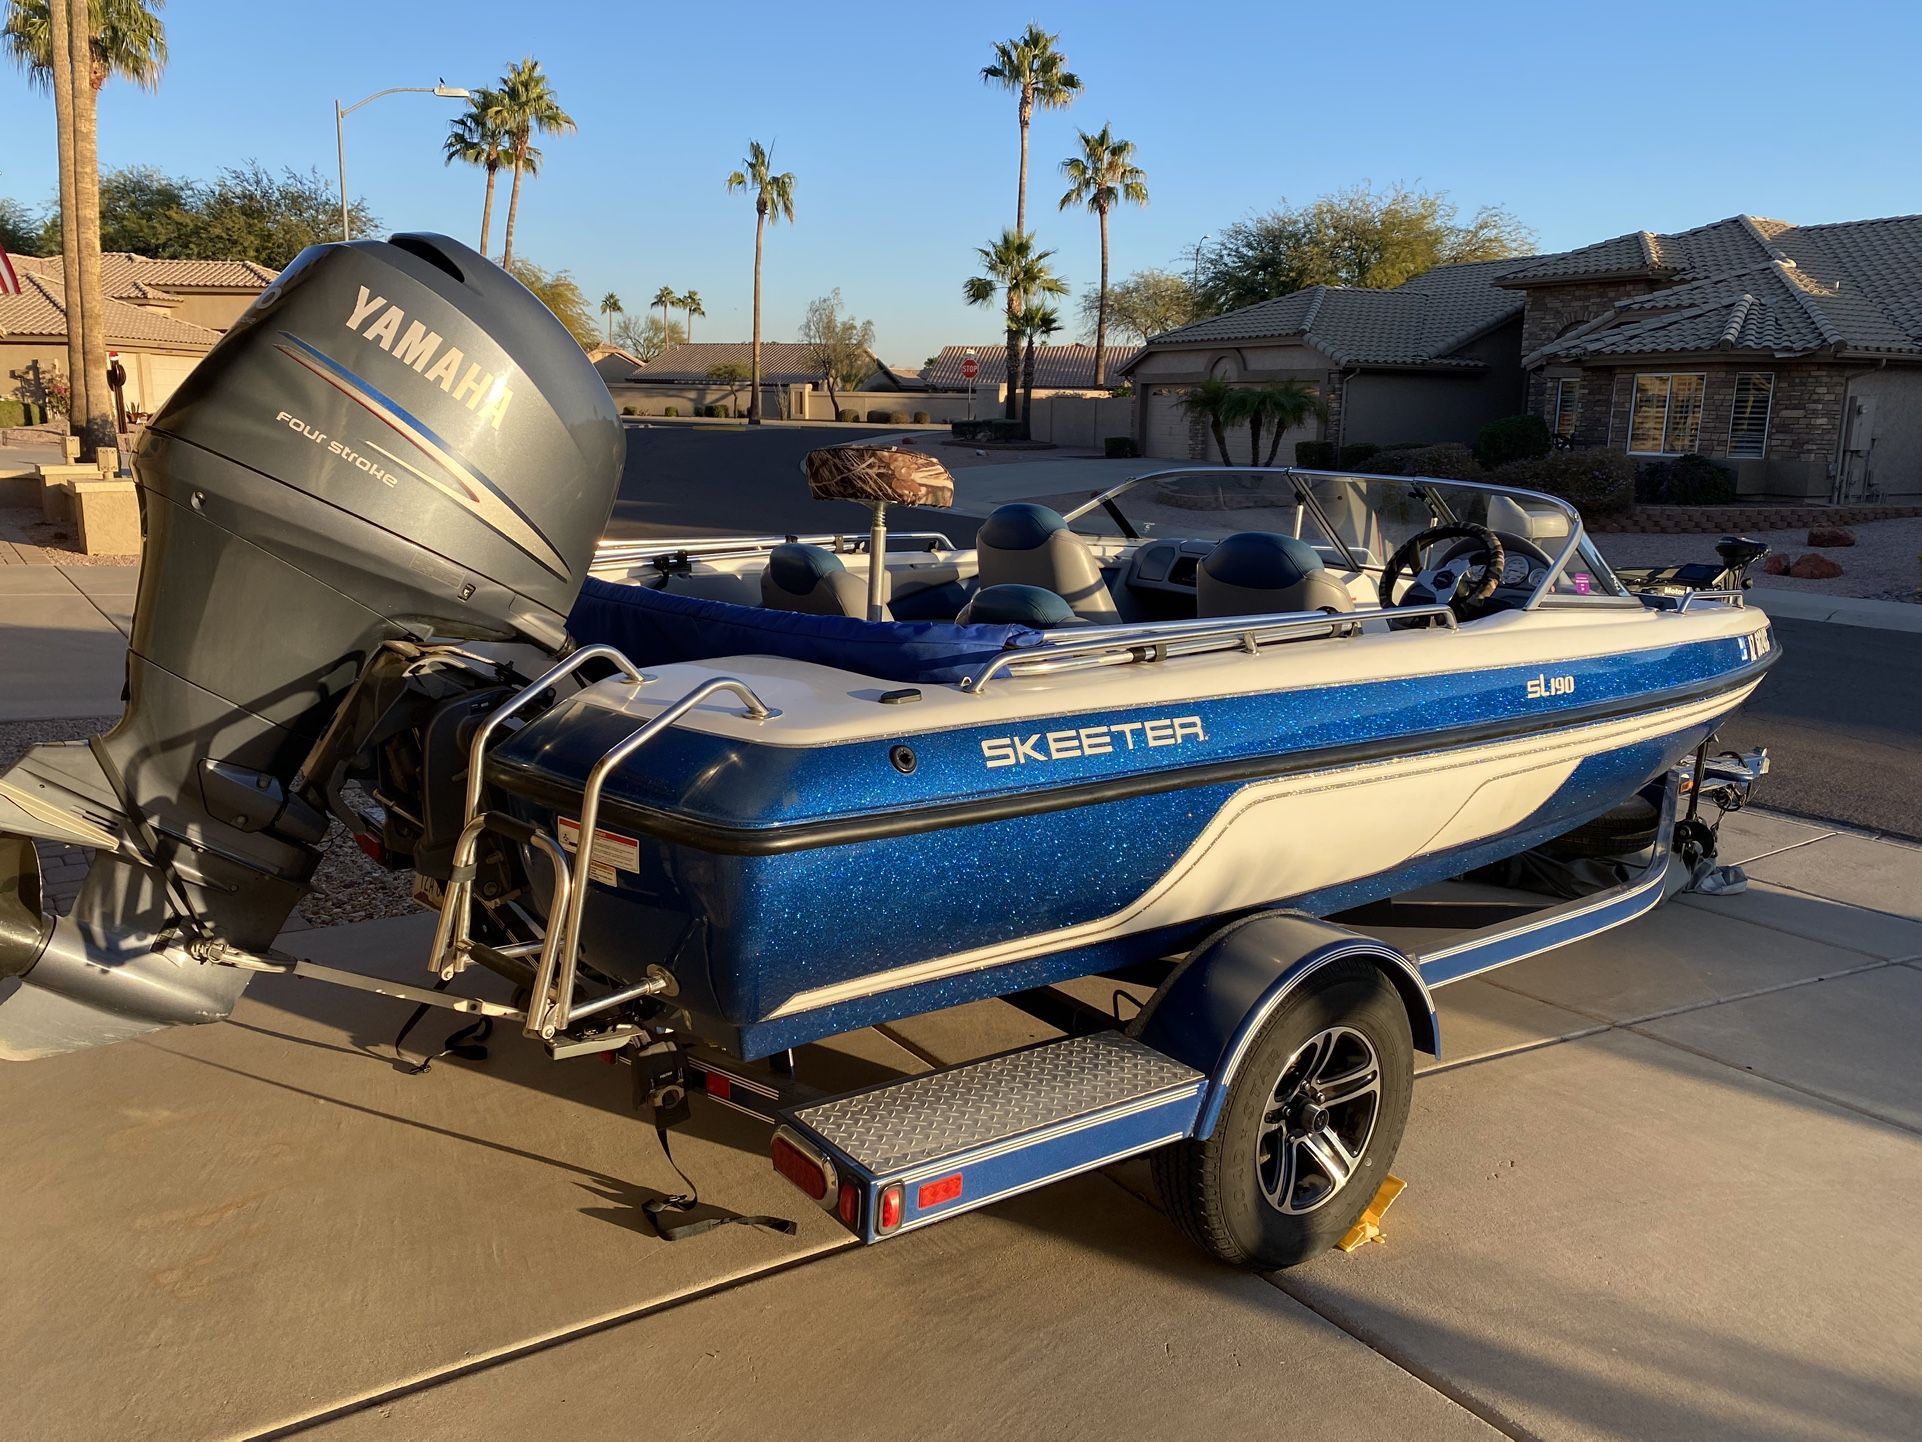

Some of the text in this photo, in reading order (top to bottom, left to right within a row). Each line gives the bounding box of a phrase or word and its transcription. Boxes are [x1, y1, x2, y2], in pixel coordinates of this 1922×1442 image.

[345, 285, 514, 430] YAMAHA
[962, 365, 978, 373] STOP
[980, 715, 1205, 768] SKEETER
